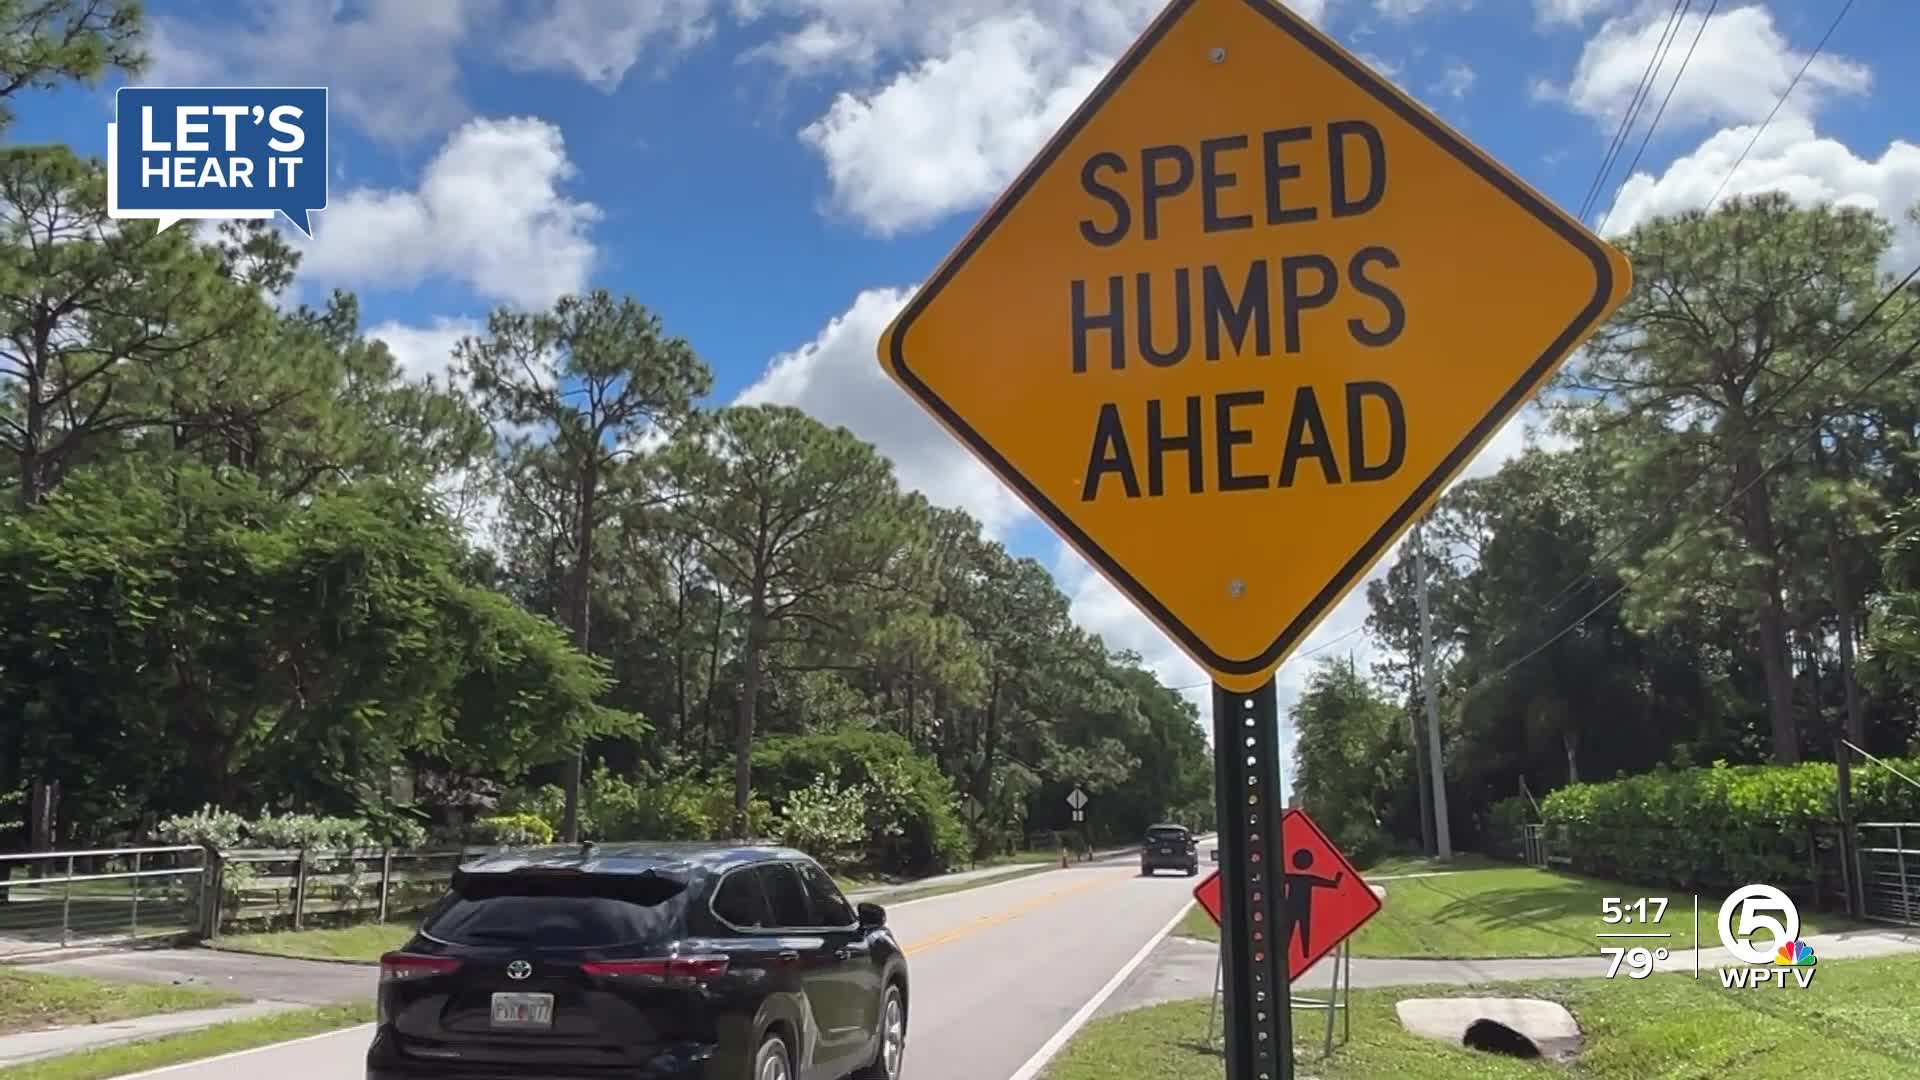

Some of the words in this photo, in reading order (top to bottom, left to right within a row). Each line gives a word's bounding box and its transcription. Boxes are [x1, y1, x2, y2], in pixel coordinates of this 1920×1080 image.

[1079, 120, 1387, 246] SPEED
[1071, 246, 1406, 374] HUMPS
[1081, 381, 1406, 502] AHEAD
